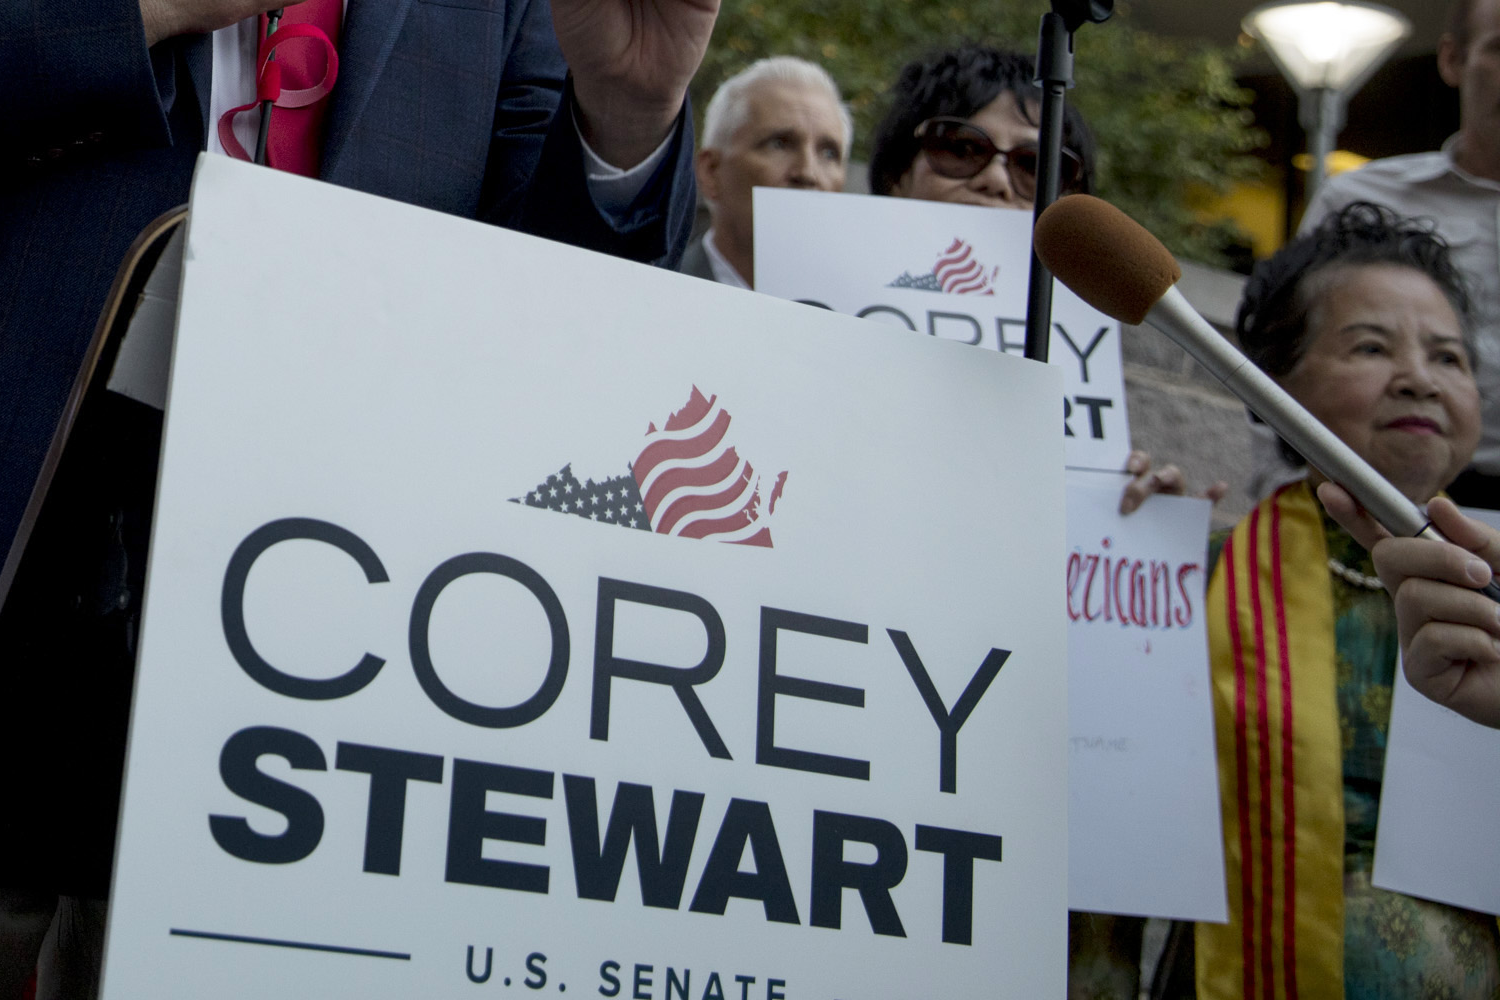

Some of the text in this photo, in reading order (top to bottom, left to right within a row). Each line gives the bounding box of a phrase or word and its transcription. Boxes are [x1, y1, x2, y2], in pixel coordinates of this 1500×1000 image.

[220, 516, 1013, 795] COREY
[207, 725, 1003, 946] STEWART
[465, 944, 787, 1000] U.S. SENATE
